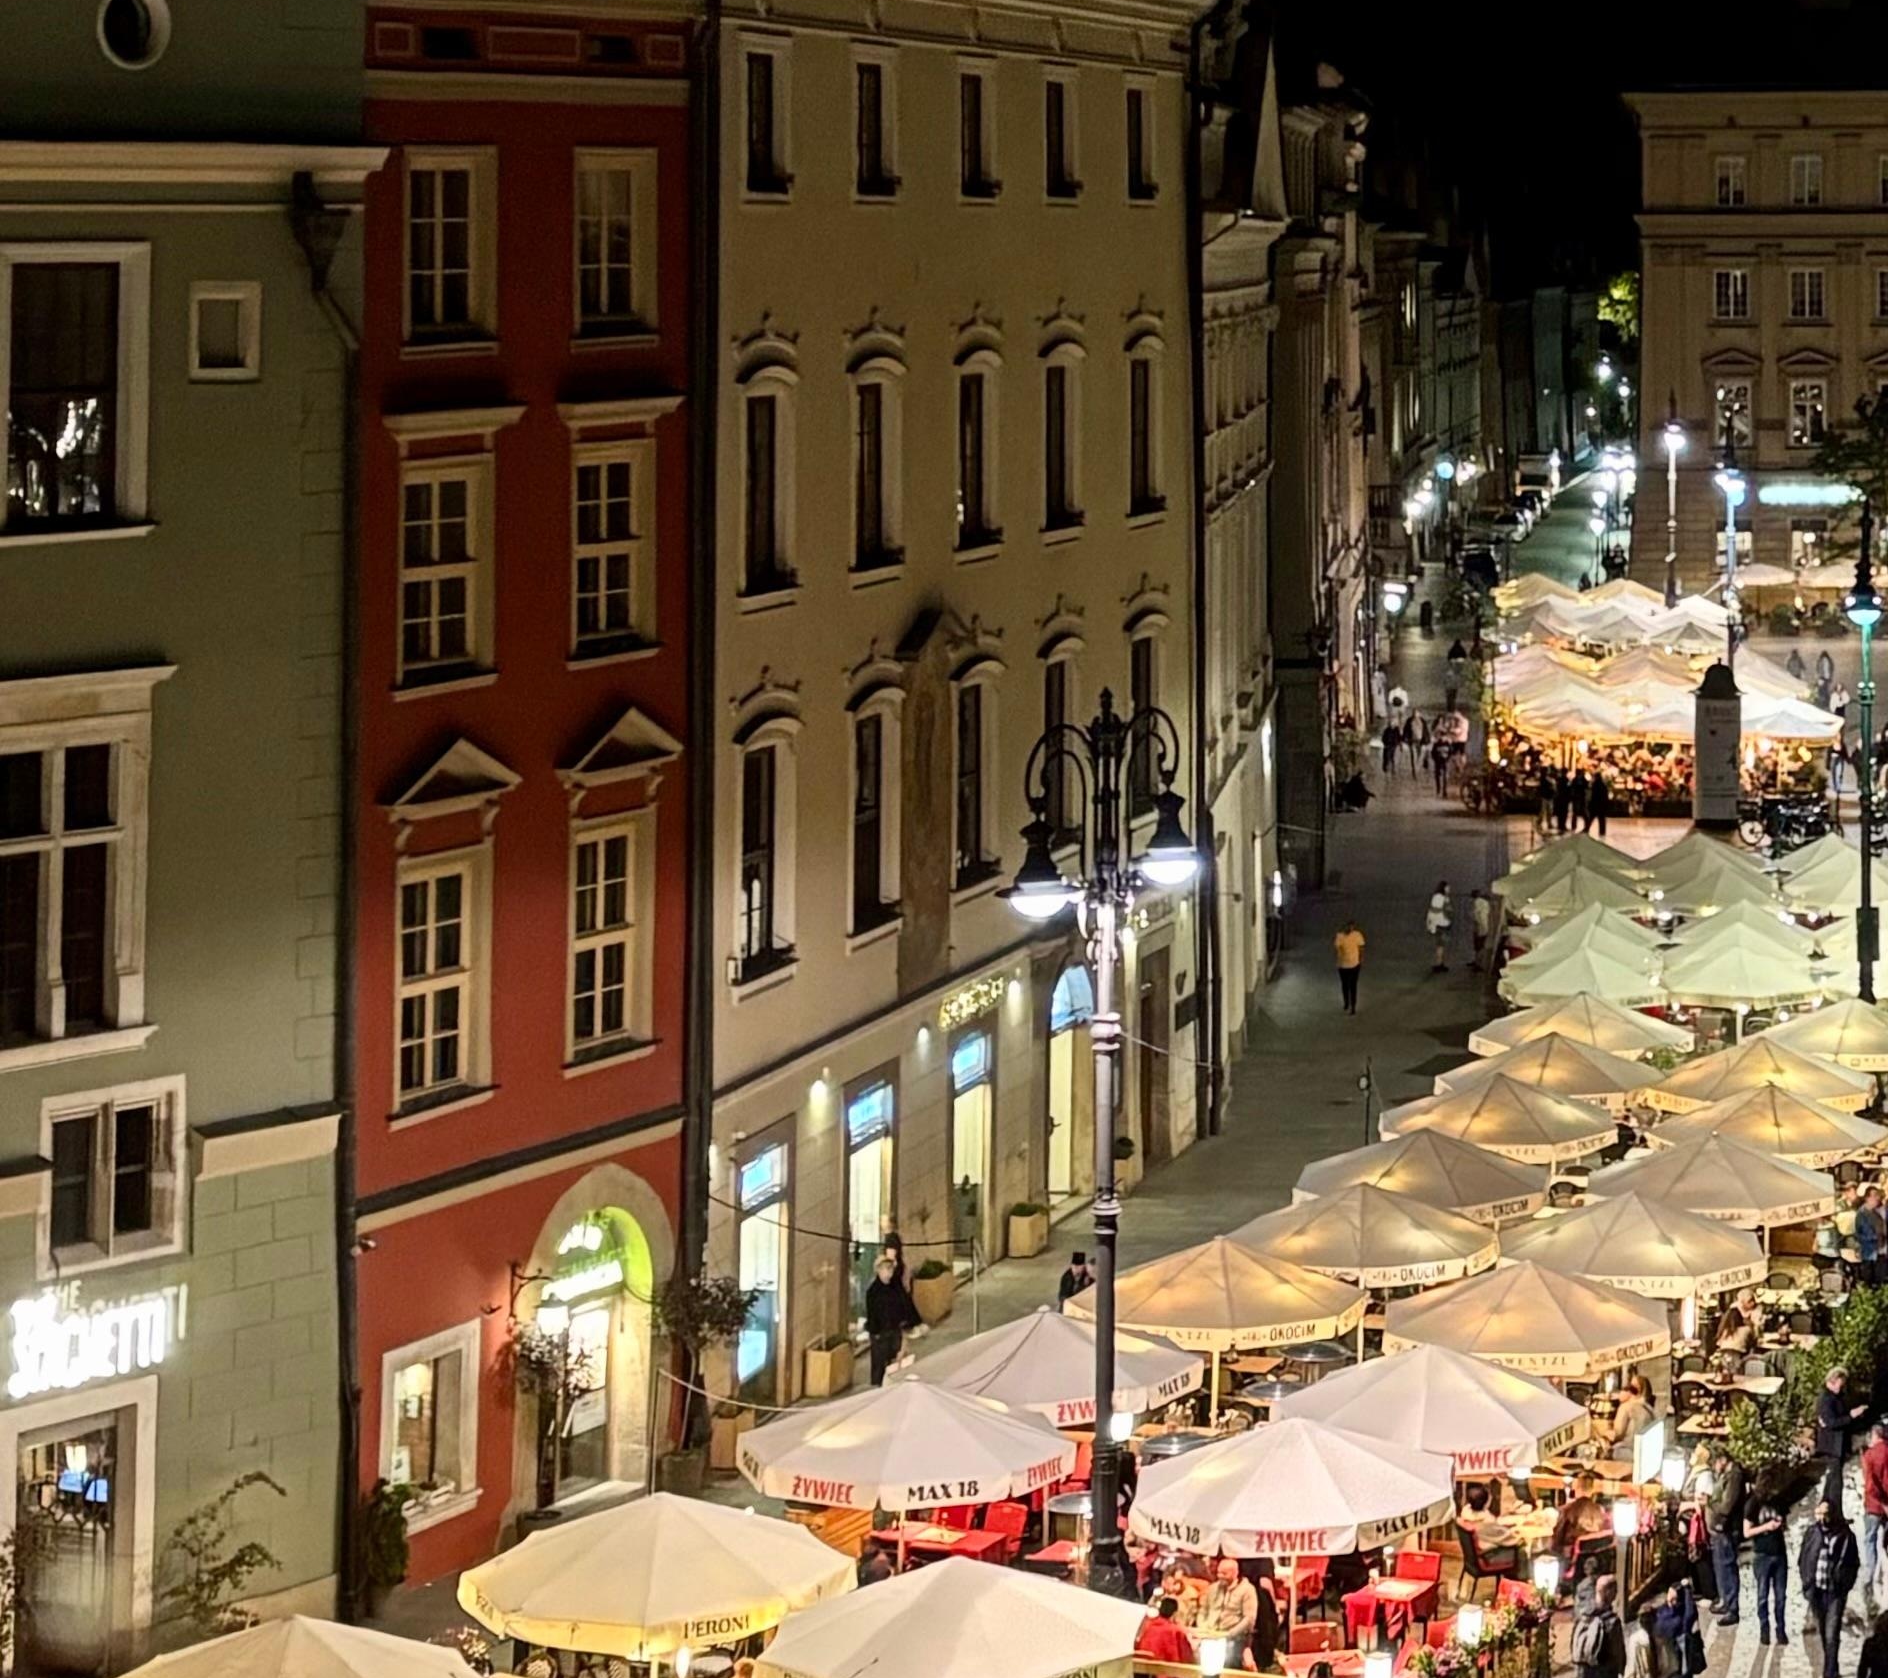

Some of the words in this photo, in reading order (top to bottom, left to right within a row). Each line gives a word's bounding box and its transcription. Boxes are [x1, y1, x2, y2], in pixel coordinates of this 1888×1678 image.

[1270, 1323, 1316, 1341] OKOCIM
[1056, 1399, 1097, 1424] ŻYW
[1452, 1447, 1512, 1471] YWIEC
[792, 1475, 854, 1505] ŻYWIEC
[907, 1482, 954, 1503] MAX
[958, 1480, 980, 1497] 18
[1150, 1517, 1182, 1542] MAX
[1185, 1526, 1201, 1546] 18
[1375, 1512, 1409, 1538] MAX
[1410, 1507, 1430, 1527] 18
[1255, 1530, 1328, 1553] ŻYWIEC
[684, 1614, 749, 1640] PERONI
